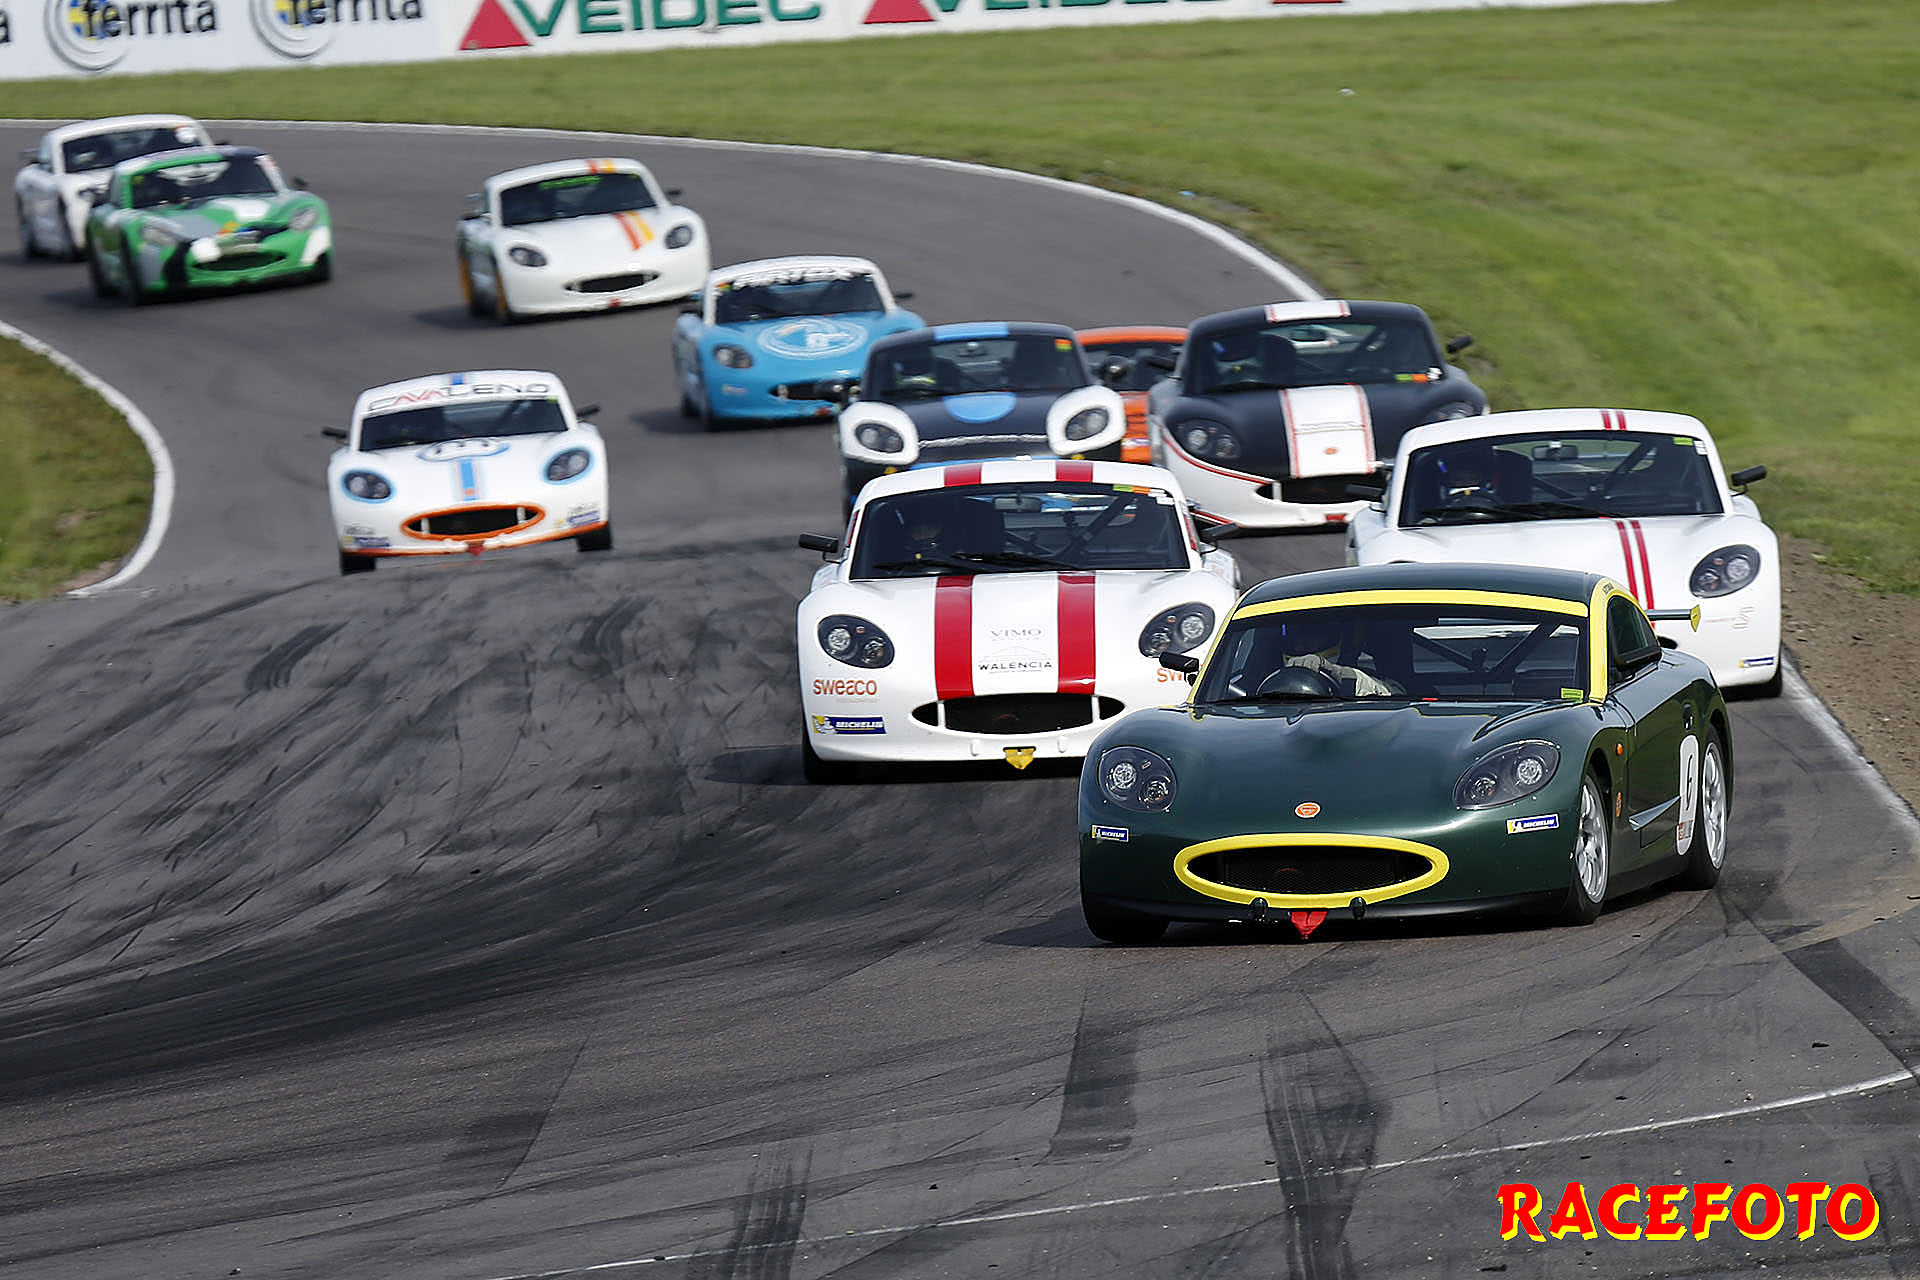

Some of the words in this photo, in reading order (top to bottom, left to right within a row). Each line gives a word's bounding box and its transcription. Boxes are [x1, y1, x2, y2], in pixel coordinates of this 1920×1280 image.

[83, 0, 217, 39] ferrita
[978, 661, 1052, 671] WALENCIA
[813, 679, 878, 696] sweaco
